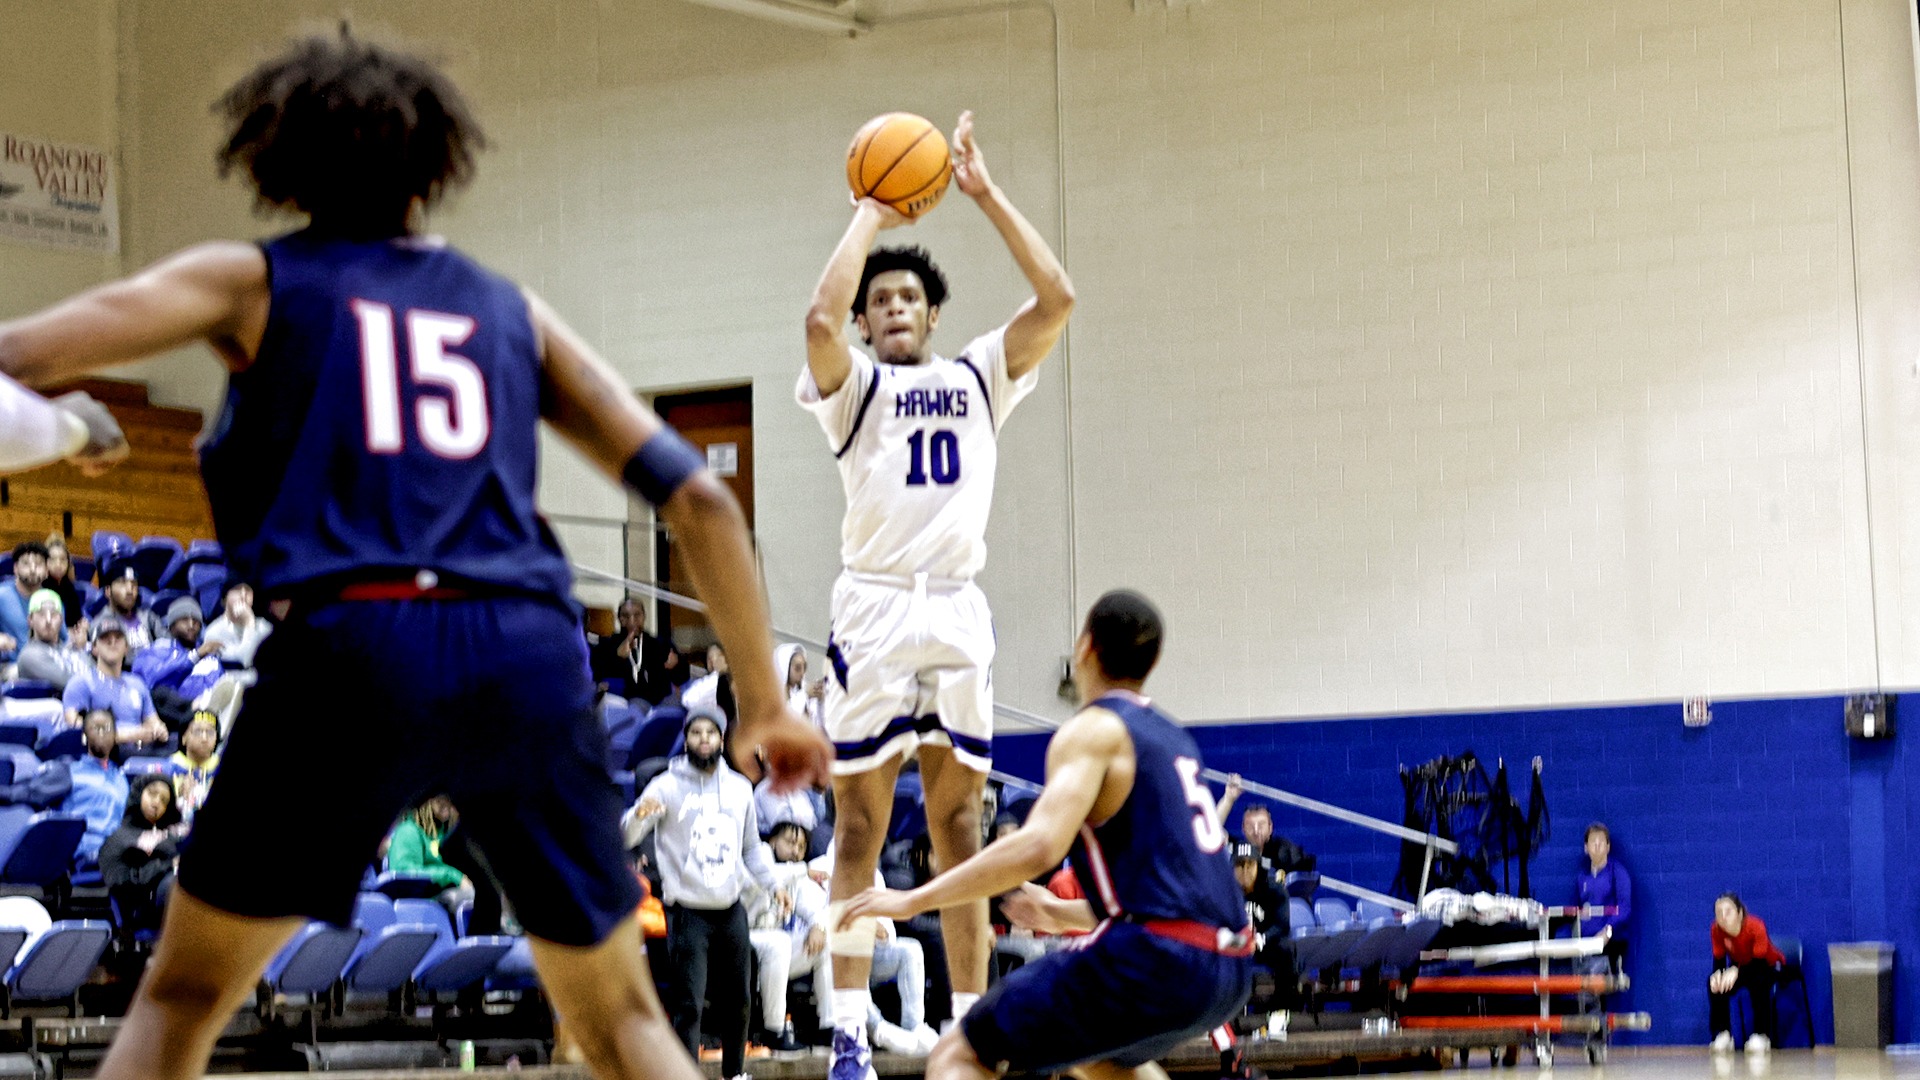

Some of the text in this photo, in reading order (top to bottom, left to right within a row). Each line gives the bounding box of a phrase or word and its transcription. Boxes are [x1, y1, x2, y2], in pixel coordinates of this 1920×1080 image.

[4, 134, 108, 176] ROANOKE
[34, 161, 108, 200] VALLEY
[349, 298, 492, 460] 15
[895, 388, 969, 418] HAWKS
[906, 428, 961, 486] 10
[1174, 755, 1225, 854] 5
